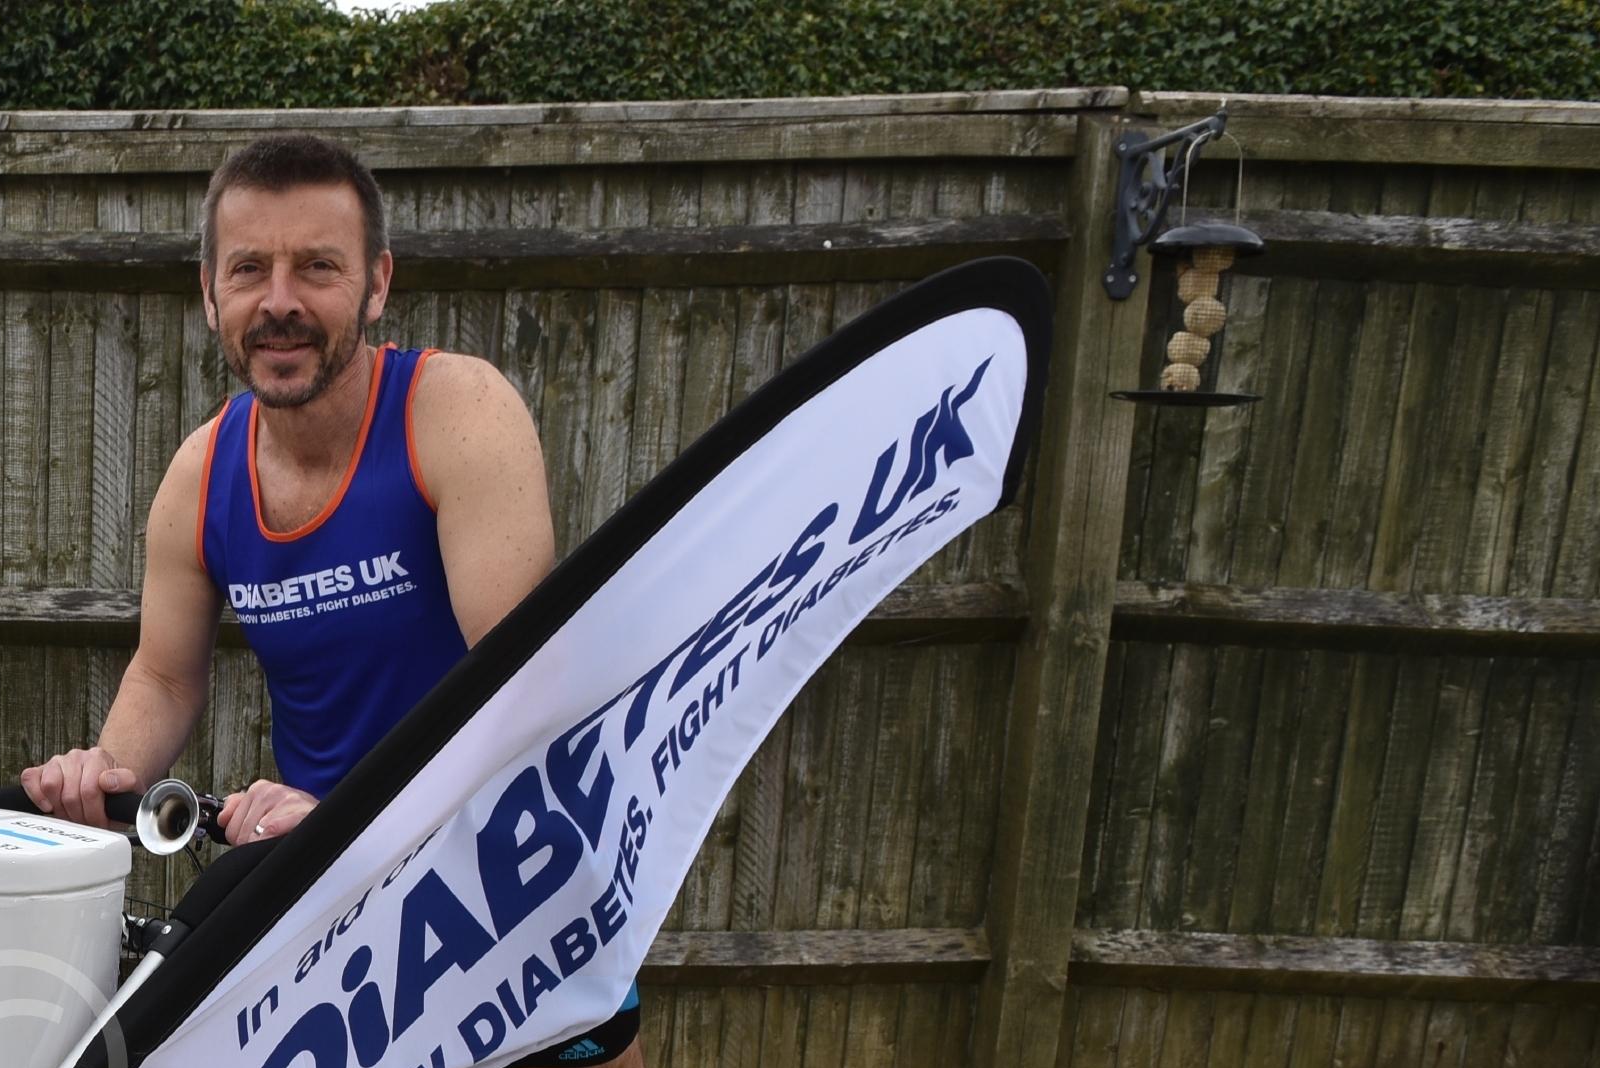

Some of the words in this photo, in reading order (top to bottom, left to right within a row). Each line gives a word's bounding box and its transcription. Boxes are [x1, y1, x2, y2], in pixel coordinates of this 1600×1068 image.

[848, 353, 996, 545] UK
[261, 607, 314, 624] DIABETES.
[316, 598, 349, 614] FIGHT
[352, 581, 417, 607] DIABETES.
[359, 551, 409, 586] UK
[457, 795, 653, 1065] DIABETES.
[651, 643, 751, 798] FIGHT
[757, 487, 961, 661] DIABETES.
[237, 985, 279, 1050] In
[294, 885, 374, 984] aid
[559, 1046, 605, 1060] adidas
